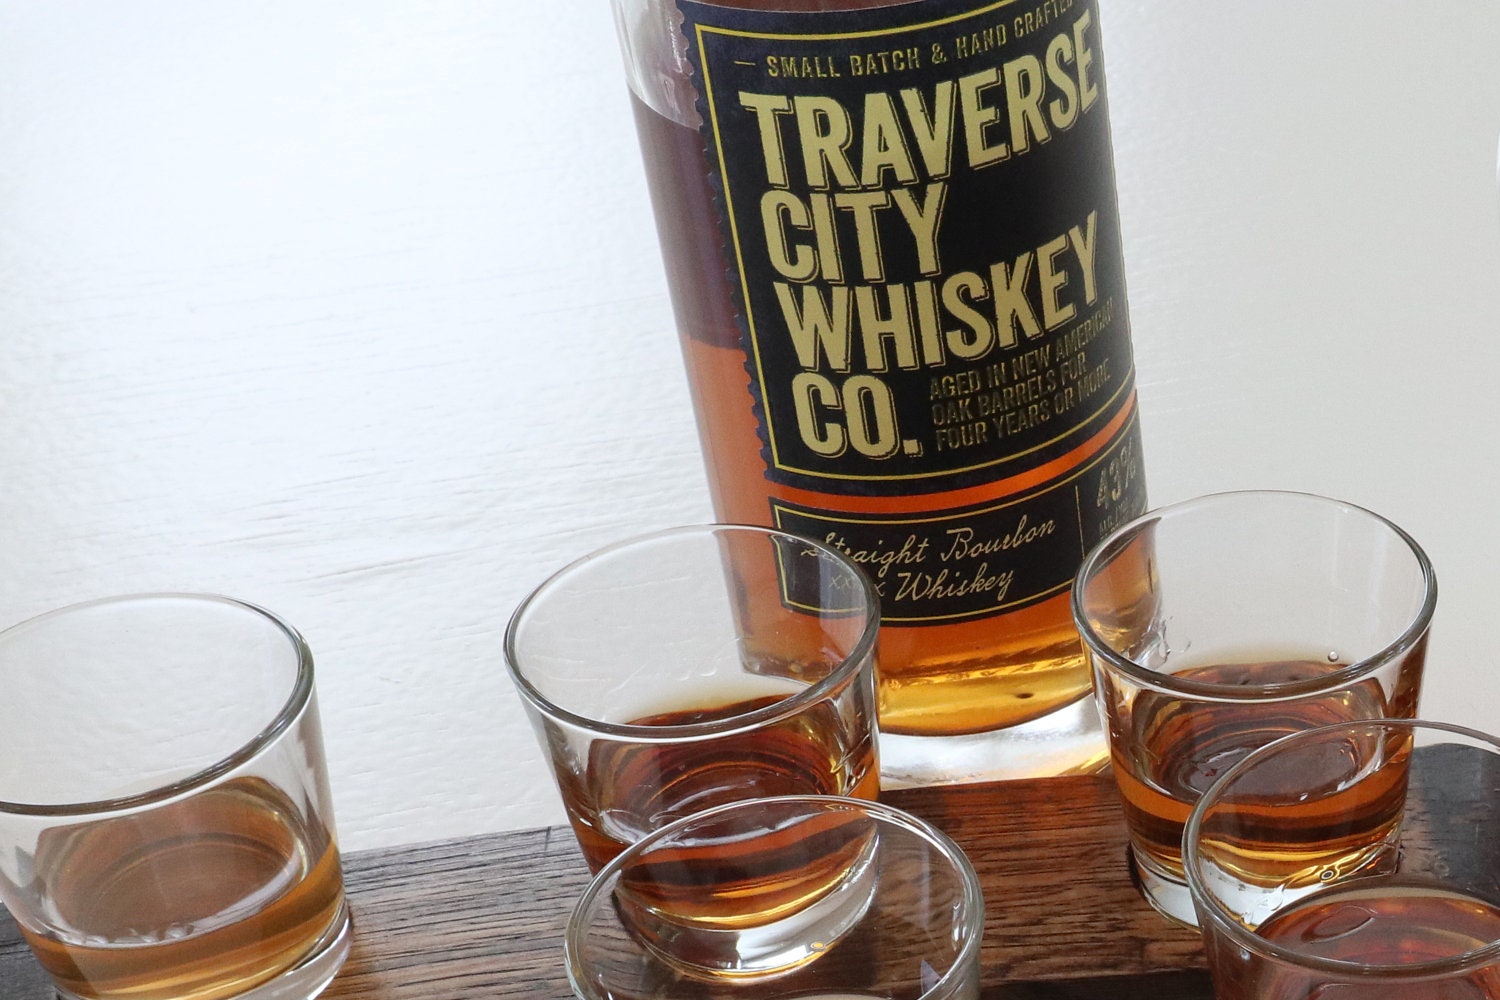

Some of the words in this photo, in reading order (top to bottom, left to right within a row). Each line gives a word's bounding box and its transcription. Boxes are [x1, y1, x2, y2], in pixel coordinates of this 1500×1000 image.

[766, 55, 841, 78] SMALL
[850, 47, 921, 77] BATCH
[931, 43, 948, 65] &
[955, 24, 1007, 59] HAND
[737, 8, 1099, 191] TRAVERSE
[760, 181, 949, 285] CITY
[773, 209, 1099, 374] WHISKEY
[929, 370, 981, 401] AGED
[987, 361, 1006, 389] IN
[1012, 345, 1051, 380] NEW
[1055, 297, 1113, 362] AMERICAN
[931, 397, 976, 425] OAK
[977, 369, 1057, 416] BARRELS
[1060, 352, 1087, 386] FOR
[791, 371, 924, 460] CO.
[935, 420, 988, 452] FOUR
[992, 399, 1050, 439] YEARS
[1054, 387, 1076, 415] OR
[1076, 358, 1111, 402] MORE
[893, 561, 1015, 602] Whiskey
[940, 514, 1056, 562] Bourbon
